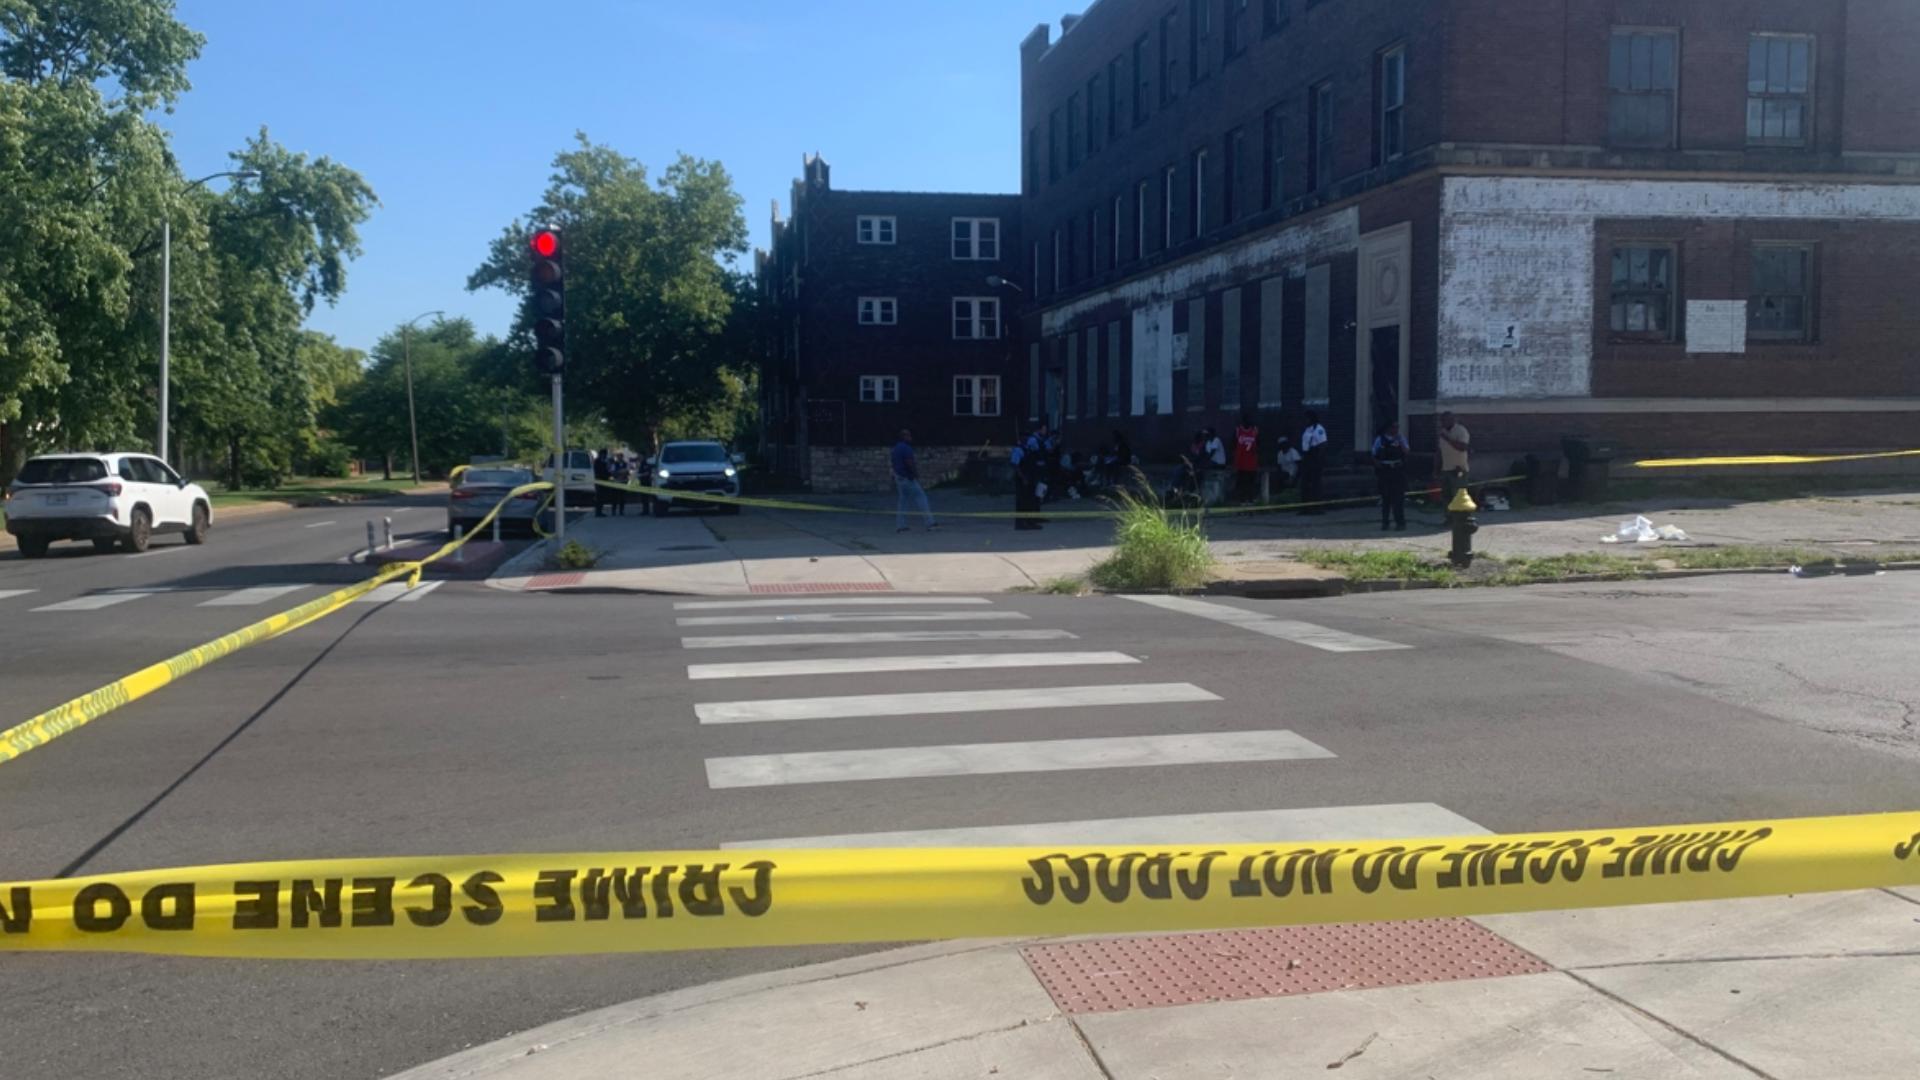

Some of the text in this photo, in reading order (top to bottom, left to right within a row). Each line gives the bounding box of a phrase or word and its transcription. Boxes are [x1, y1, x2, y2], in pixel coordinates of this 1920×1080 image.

[535, 860, 773, 923] CRIME
[1021, 827, 1772, 906] CRIME SCENE DO NOT CROSS
[74, 882, 195, 934] DO
[233, 870, 504, 931] SCENE
